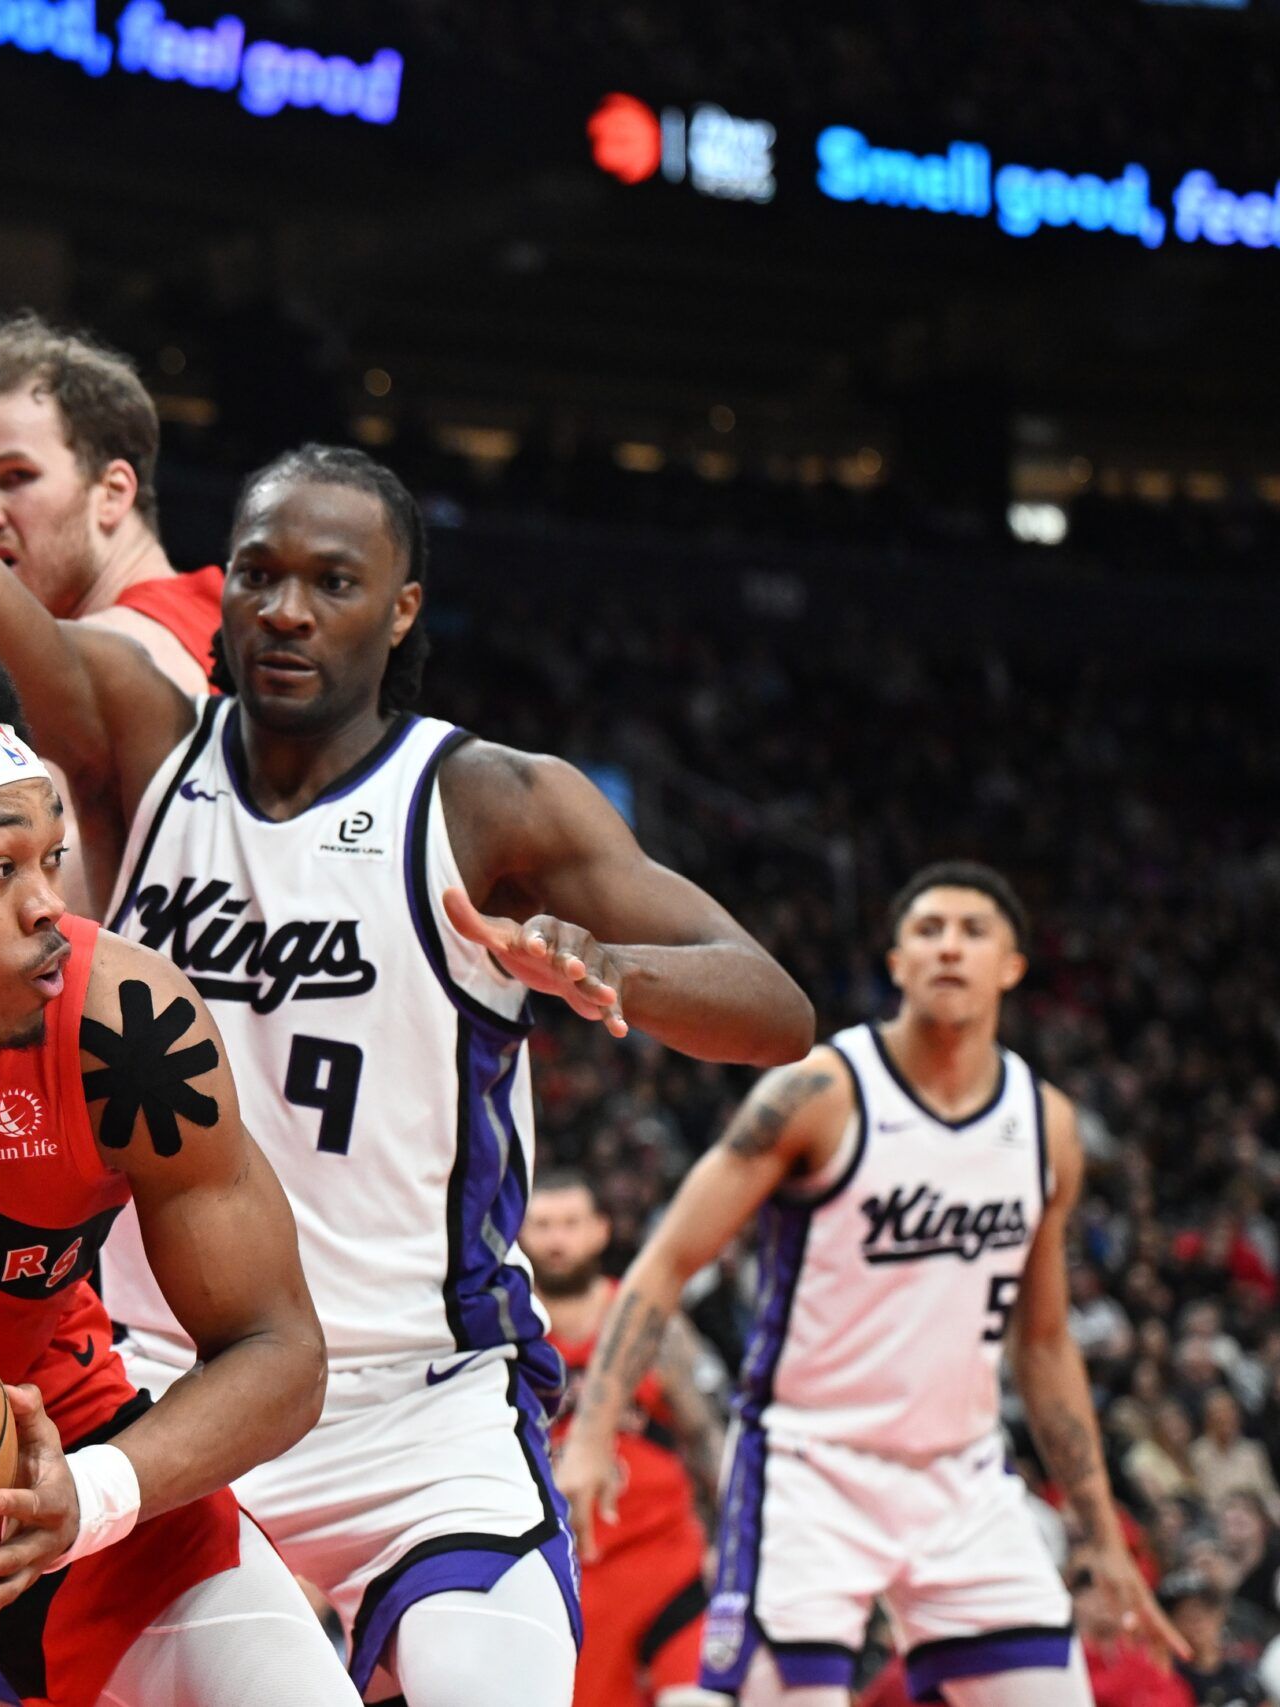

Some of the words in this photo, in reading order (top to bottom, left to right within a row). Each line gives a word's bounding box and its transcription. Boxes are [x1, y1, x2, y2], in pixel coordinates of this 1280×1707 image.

[118, 0, 243, 90] feel
[240, 40, 403, 124] good
[817, 125, 992, 217] Smell
[996, 163, 1166, 249] good,
[1173, 168, 1280, 248] fee
[135, 876, 377, 1015] Kings
[22, 1138, 58, 1158] Life
[284, 1033, 364, 1156] 9
[861, 1185, 1027, 1264] Kings
[982, 1275, 1022, 1342] 5
